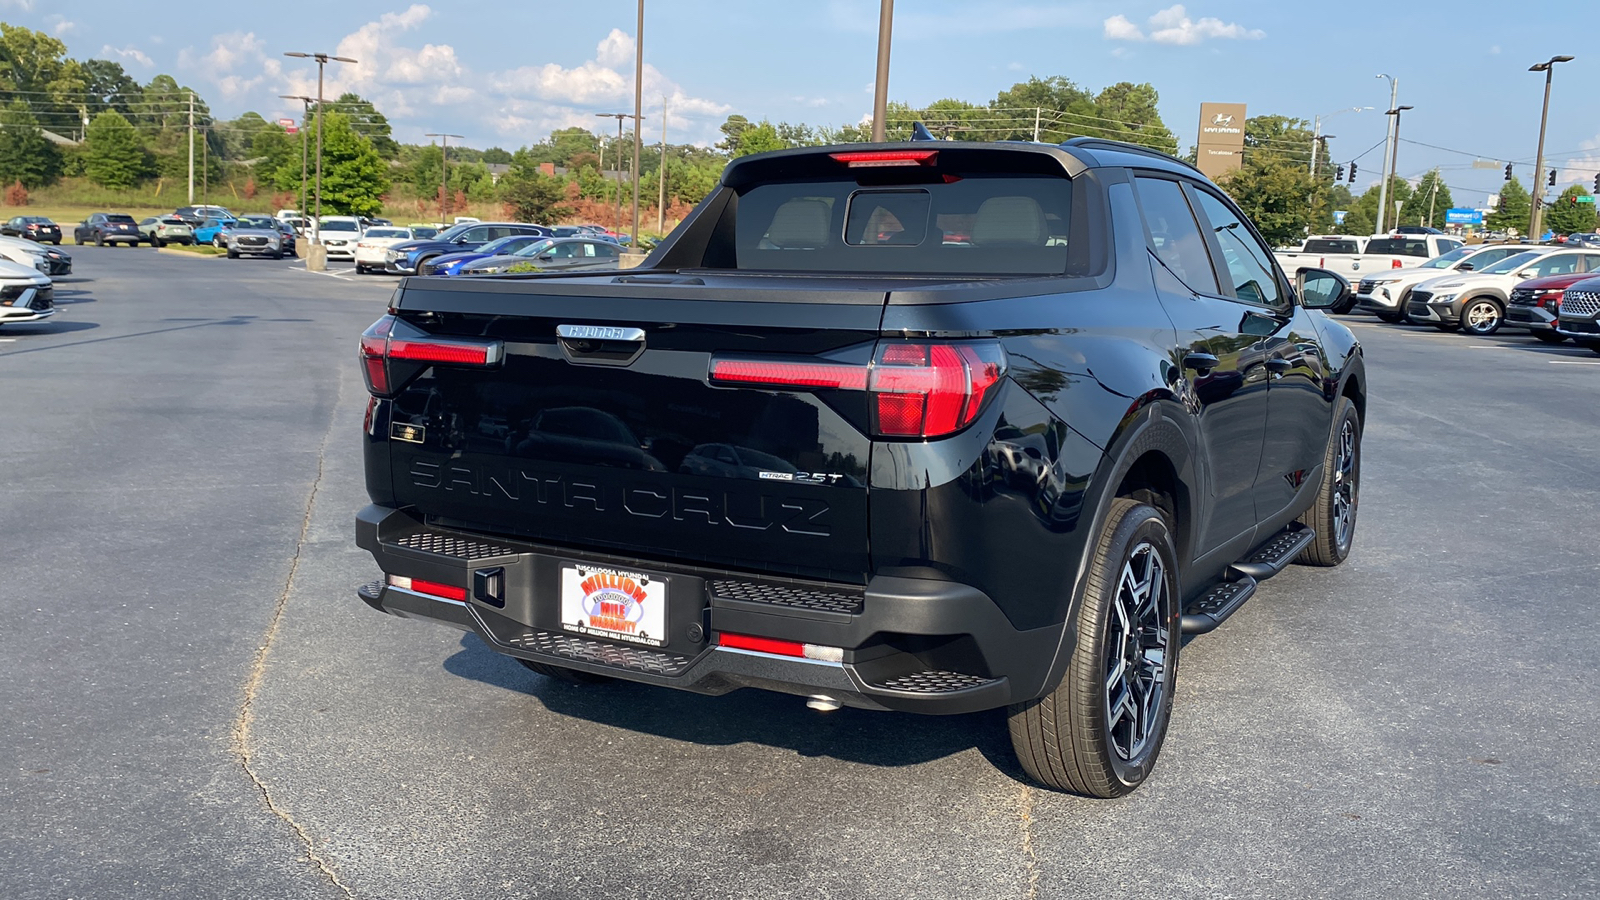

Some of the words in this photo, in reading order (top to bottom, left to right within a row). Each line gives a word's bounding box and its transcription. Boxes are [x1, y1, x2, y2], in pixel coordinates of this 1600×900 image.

[569, 326, 625, 339] HYUNDAI
[760, 472, 791, 480] HTRAC
[409, 456, 605, 512] SANTA
[623, 484, 832, 537] CRUZ
[575, 564, 616, 574] TUSCALOOSA
[617, 570, 649, 580] HYUNDAI
[580, 573, 647, 604] MILLION
[600, 602, 625, 619] MILE
[563, 624, 579, 632] HOME
[587, 628, 609, 637] MILLION
[608, 631, 621, 639] MILE
[589, 615, 637, 633] WARRANTY
